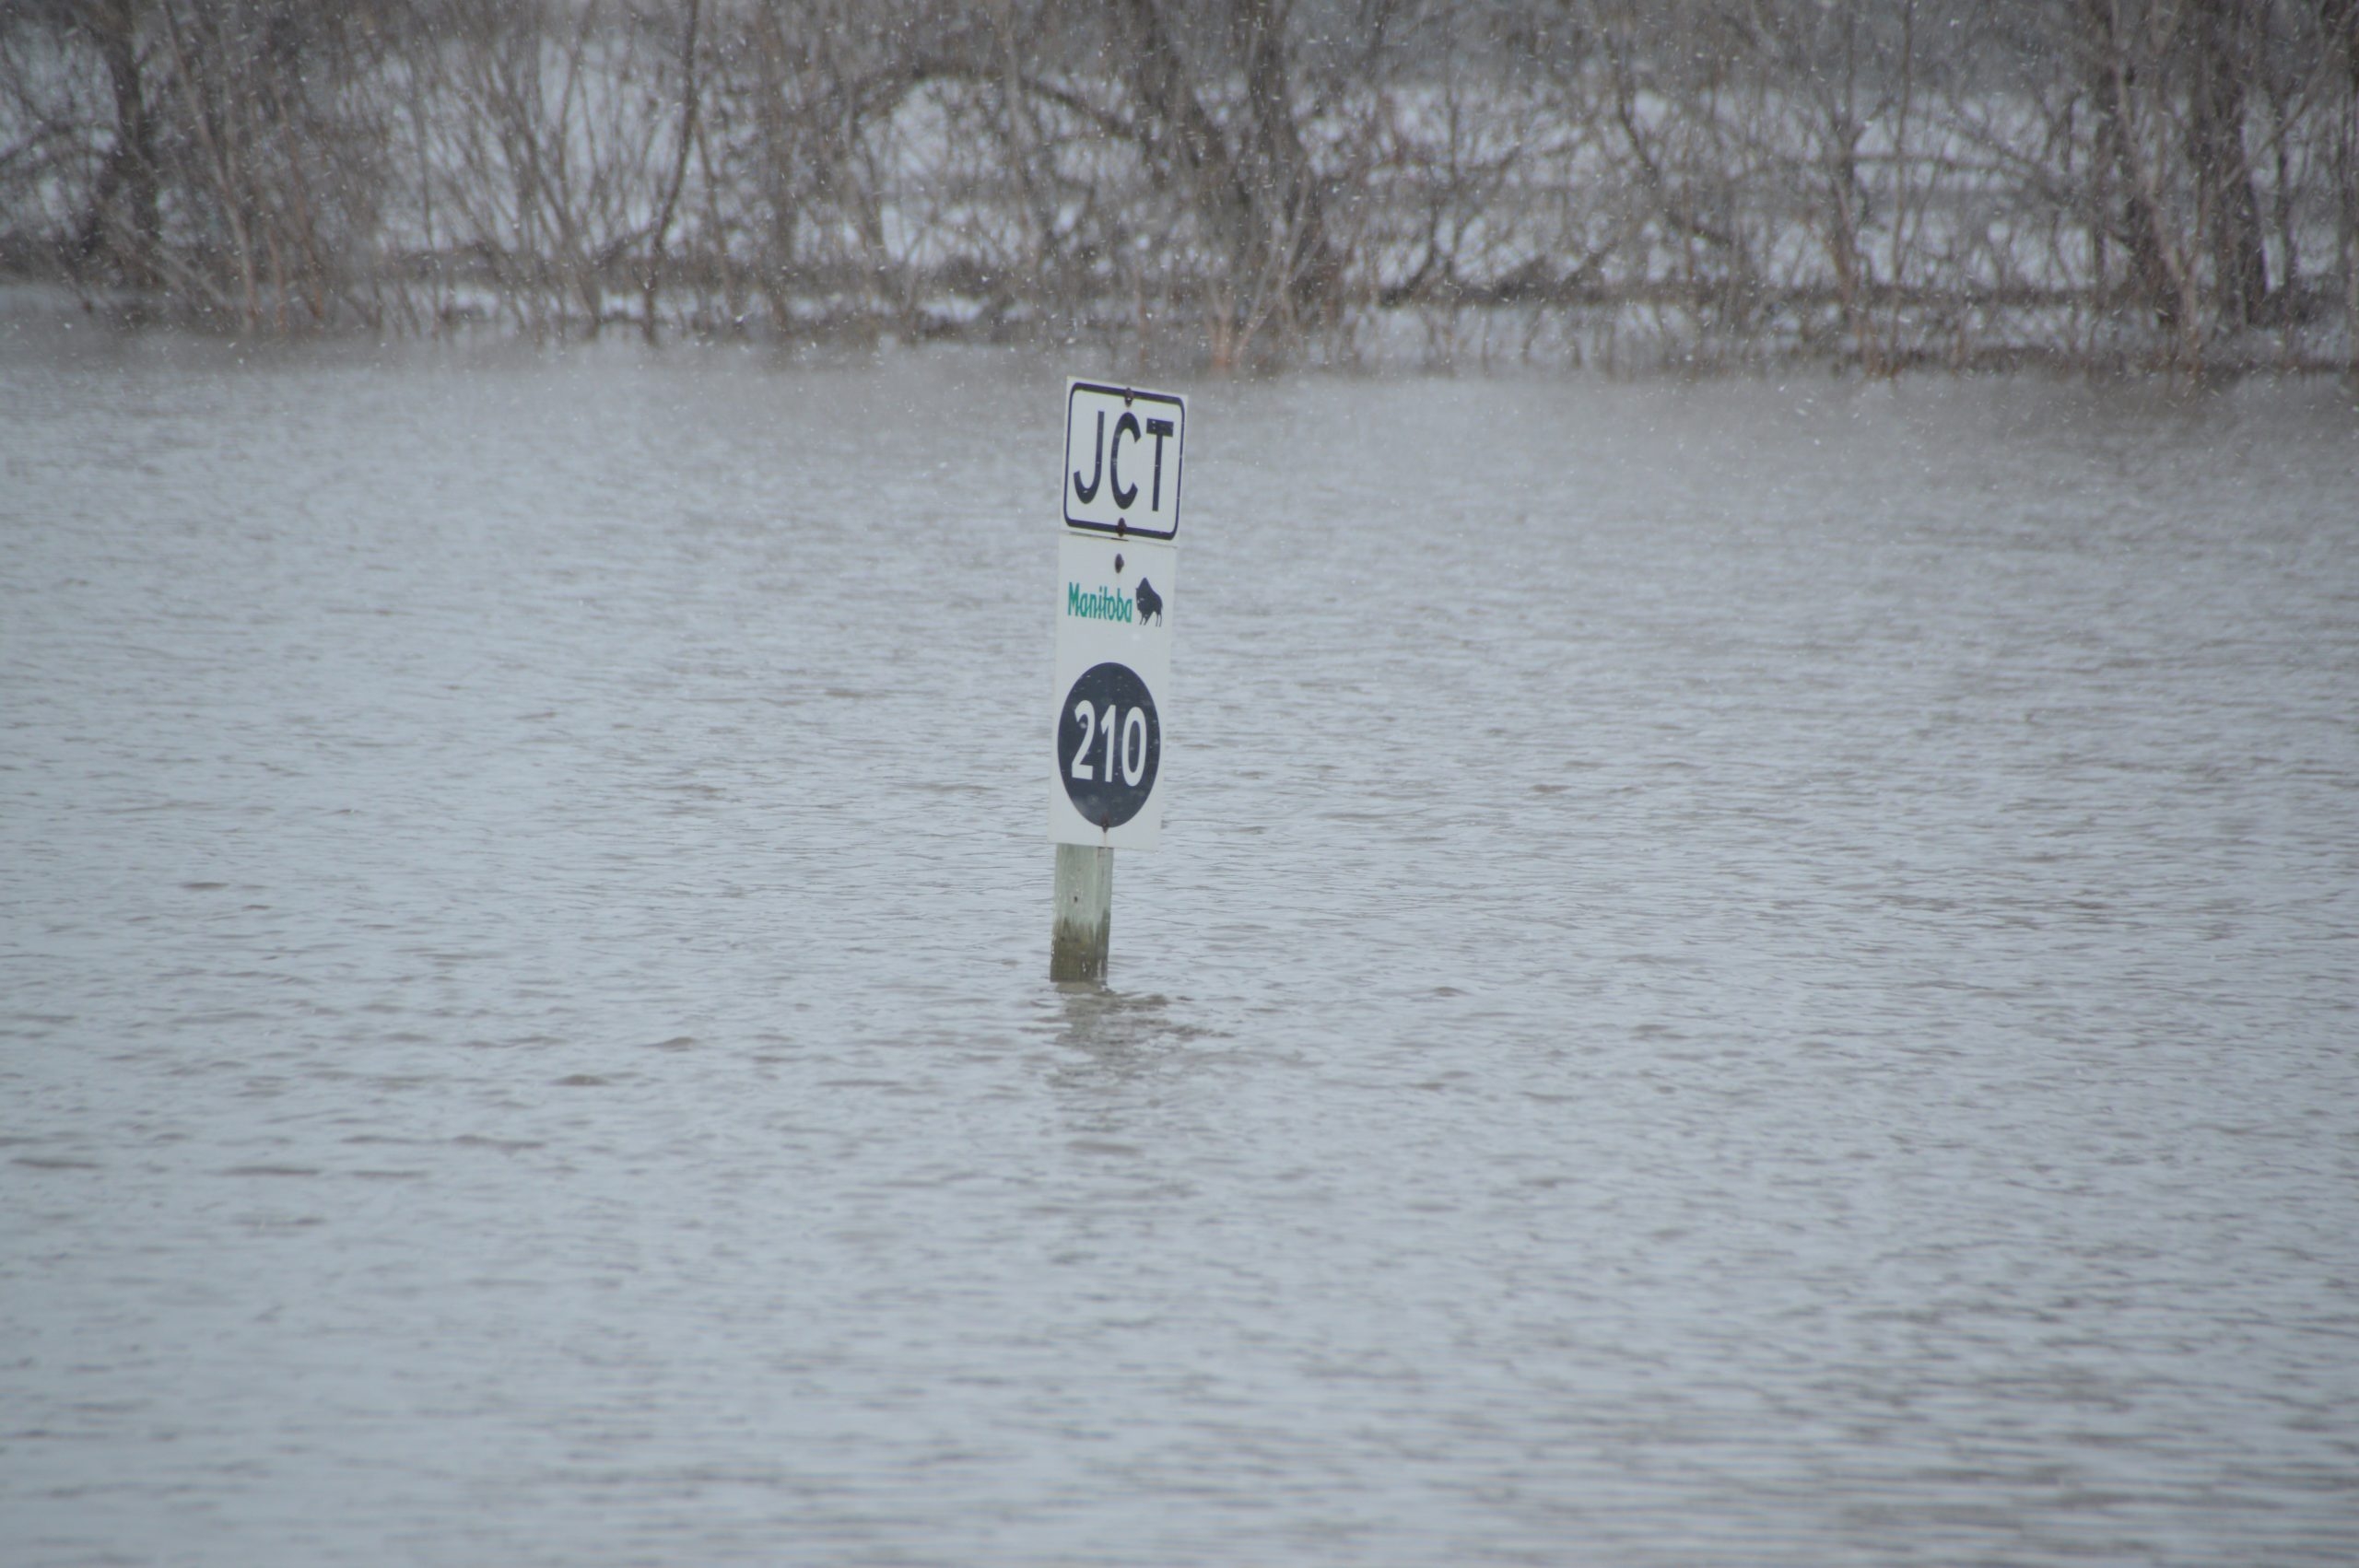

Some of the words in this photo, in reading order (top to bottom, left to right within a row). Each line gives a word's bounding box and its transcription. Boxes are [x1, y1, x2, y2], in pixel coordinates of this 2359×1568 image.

[1074, 411, 1174, 512] JCT
[1067, 581, 1133, 624] Manitoba
[1071, 699, 1147, 787] 210
